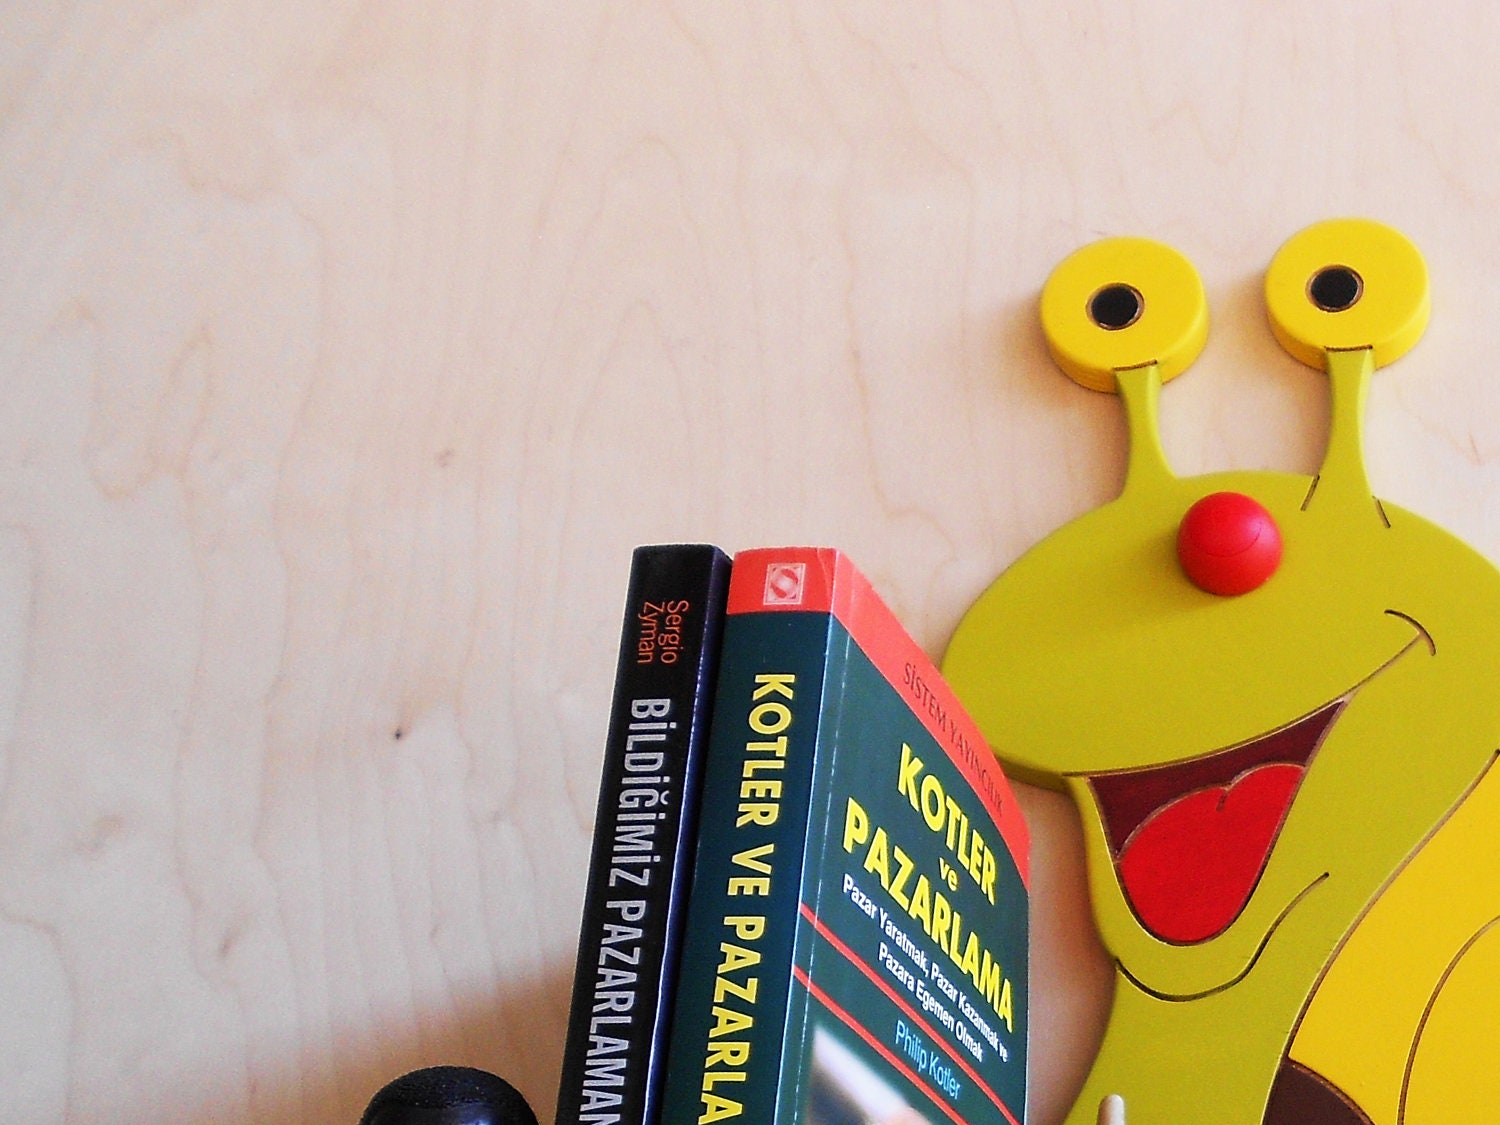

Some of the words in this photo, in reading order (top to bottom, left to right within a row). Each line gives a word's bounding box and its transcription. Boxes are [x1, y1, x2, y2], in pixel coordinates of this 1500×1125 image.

[637, 601, 666, 664] Zyman
[658, 599, 689, 664] Sergio
[904, 662, 947, 732] SİSTEM
[609, 698, 677, 887] BİLDİĞİMİZ
[735, 674, 796, 828] KOTLER
[727, 844, 774, 896] VE
[898, 742, 997, 905] KOTLER
[843, 797, 1014, 1033] PAZARLAMA
[938, 856, 958, 892] ve
[843, 873, 877, 919] Pazar
[878, 907, 929, 977] Yaratmak,
[930, 962, 958, 1003] Pazar
[958, 991, 1000, 1051] Kazanmak
[999, 1042, 1008, 1063] ve
[878, 941, 915, 992] Pazara
[916, 979, 955, 1033] Egemen
[955, 1024, 983, 1062] Olmak
[895, 1020, 928, 1073] Philip
[928, 1051, 961, 1100] Kotler
